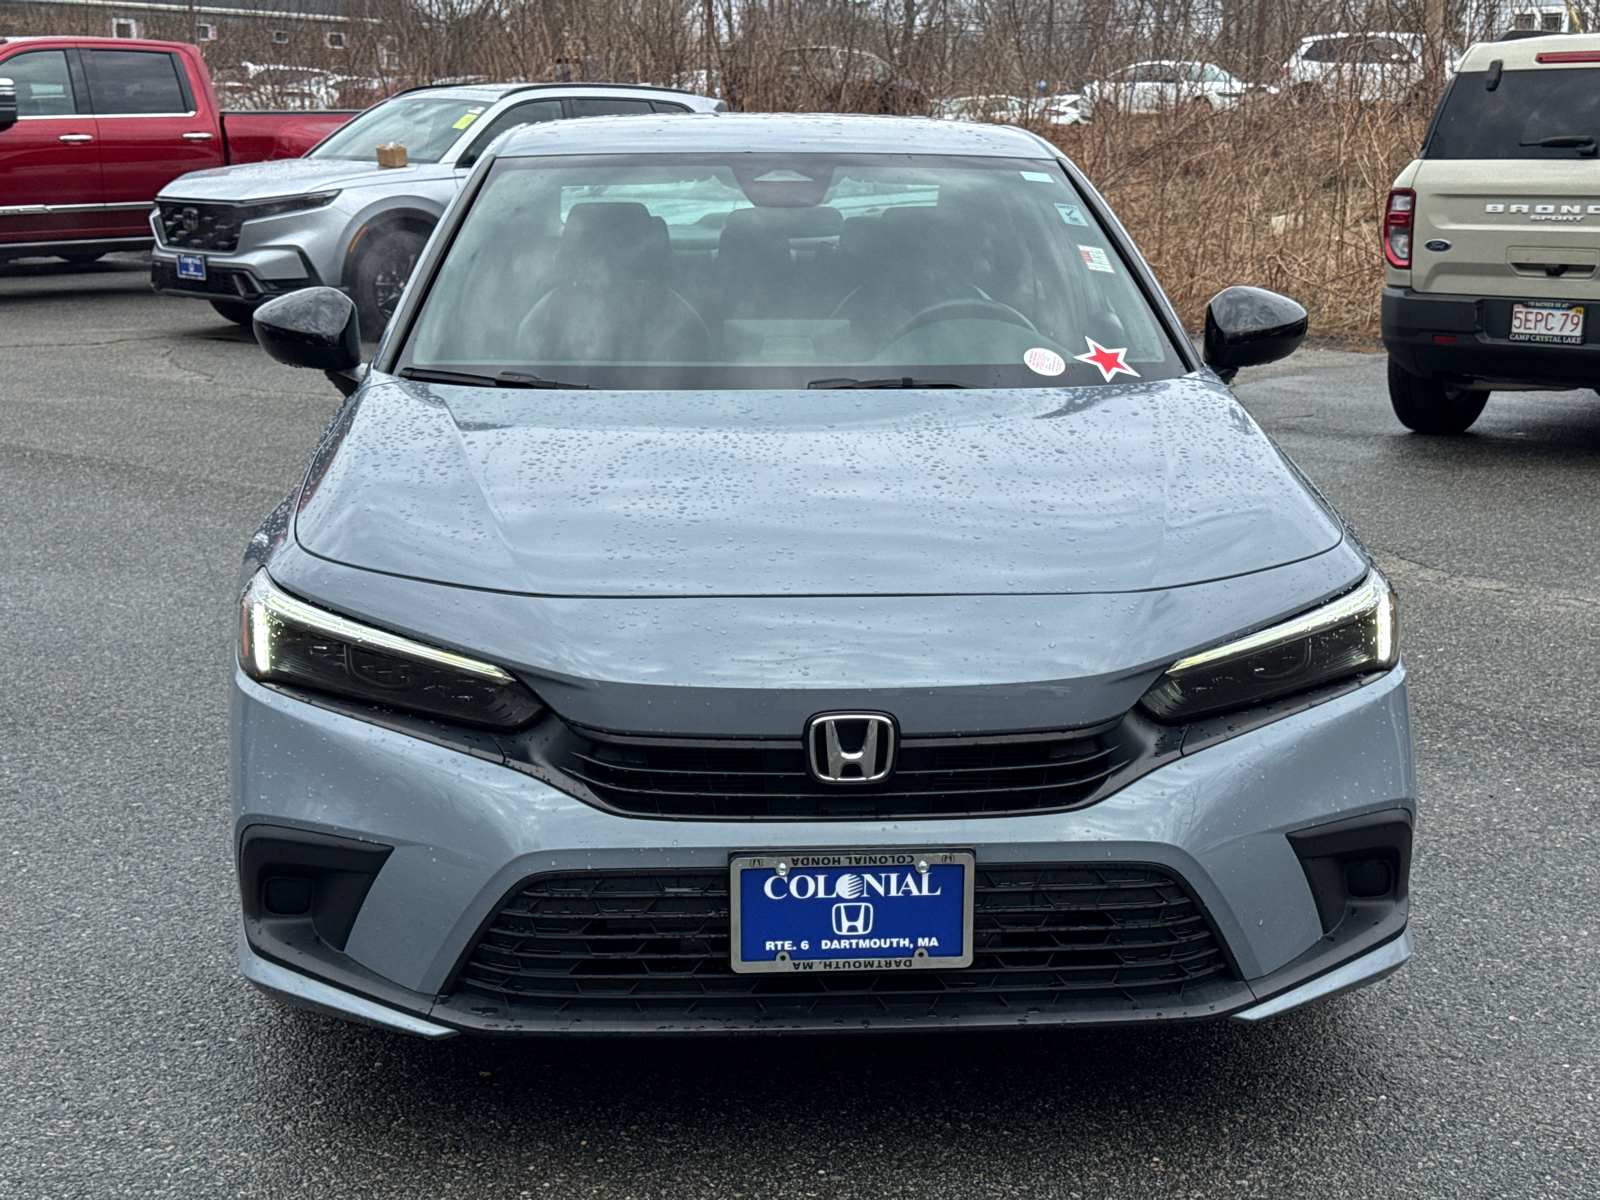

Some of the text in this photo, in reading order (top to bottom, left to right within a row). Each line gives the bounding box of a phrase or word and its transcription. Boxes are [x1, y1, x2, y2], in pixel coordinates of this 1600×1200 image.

[1513, 310, 1581, 333] 5EPC 79
[1509, 333, 1582, 344] CAMP CRYSTAL LAKE
[790, 854, 915, 867] COLONIAL HONDA
[763, 872, 942, 900] COLONIAL
[765, 936, 940, 952] RTE. 6 DARTMOUTH, MA
[792, 958, 913, 971] DARTMOUTH, MA
